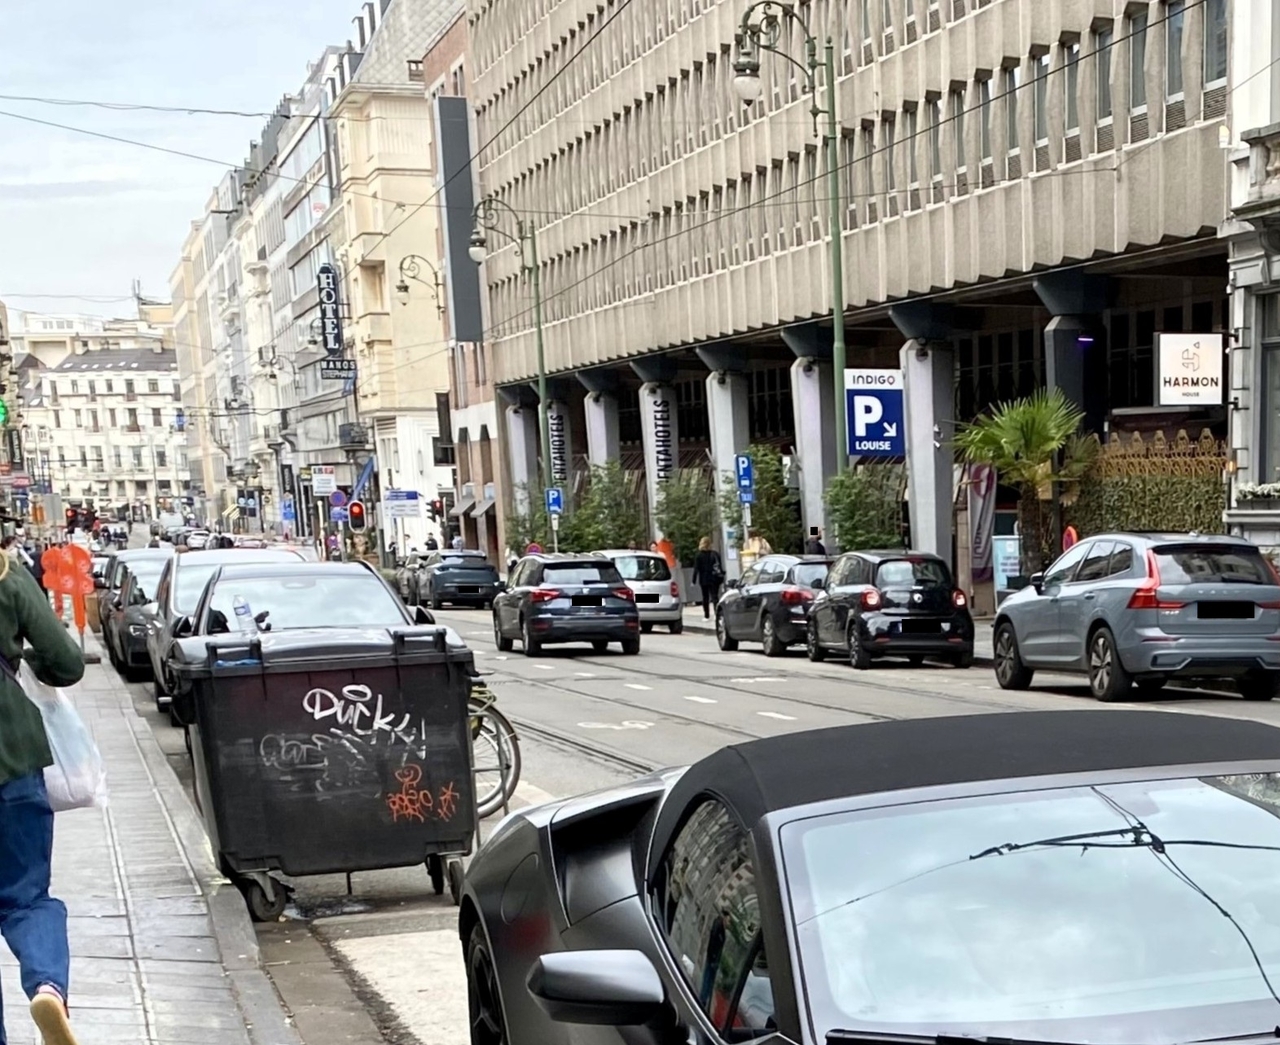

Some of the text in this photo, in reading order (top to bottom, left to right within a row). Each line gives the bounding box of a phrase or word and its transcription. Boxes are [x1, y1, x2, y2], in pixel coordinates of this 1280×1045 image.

[319, 273, 339, 349] HOTEL
[852, 374, 896, 386] INDIGO
[1163, 376, 1219, 388] HARMON
[853, 395, 883, 437] P
[653, 400, 673, 484] ENTAHOTELS
[855, 440, 892, 451] LOUISE
[739, 456, 749, 476] P
[549, 490, 558, 504] P
